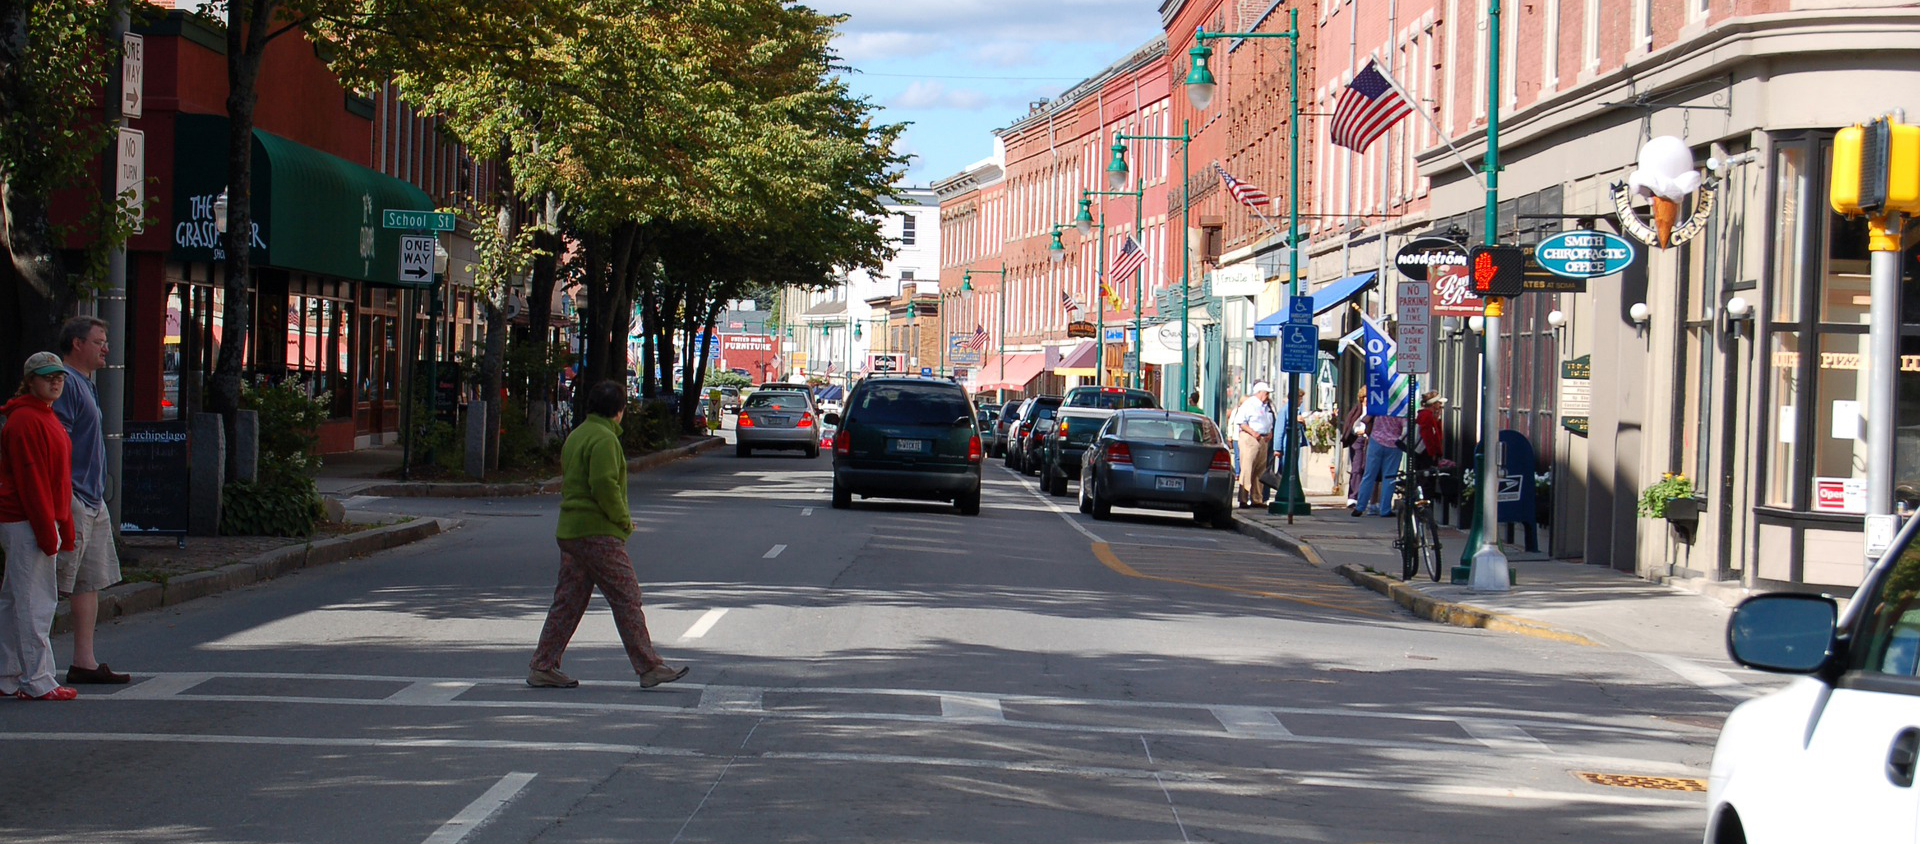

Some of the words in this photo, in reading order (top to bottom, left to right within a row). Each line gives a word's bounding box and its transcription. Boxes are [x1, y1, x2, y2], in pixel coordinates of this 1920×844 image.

[125, 42, 141, 61] ONE
[125, 64, 141, 84] WAY
[125, 138, 136, 158] NO
[123, 164, 137, 180] TURN
[190, 194, 213, 220] THE
[389, 212, 426, 227] School
[438, 214, 449, 228] St
[1671, 186, 1714, 246] CREAMERY
[176, 220, 266, 249] GRASSHR
[405, 239, 431, 251] ONE
[1564, 236, 1605, 247] SMITH
[404, 252, 431, 264] WAY
[1543, 248, 1627, 260] CHIROPRACTIC
[1565, 261, 1605, 272] OFFICE
[1407, 286, 1420, 295] NO
[1399, 297, 1428, 306] PARKING
[1400, 327, 1425, 335] LOADING
[724, 342, 772, 351] FURNITURE
[1367, 339, 1385, 405] OPEN
[130, 430, 187, 442] archipelago
